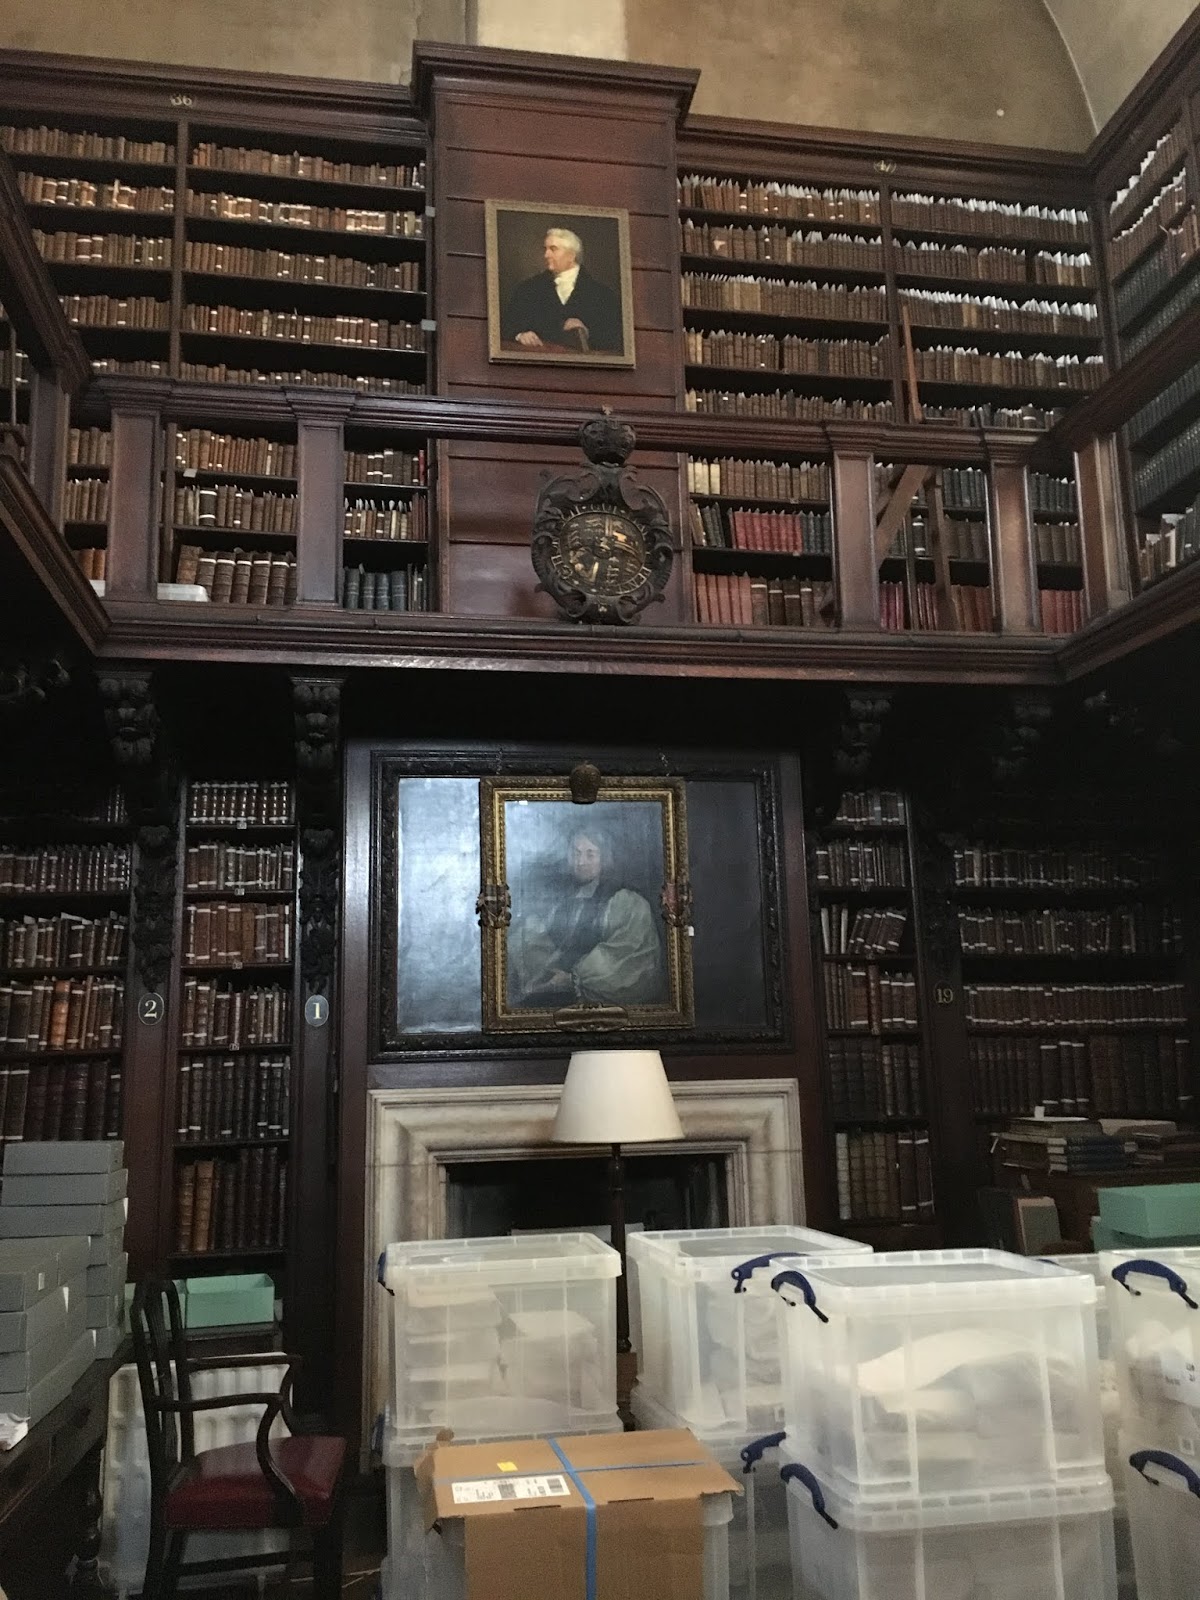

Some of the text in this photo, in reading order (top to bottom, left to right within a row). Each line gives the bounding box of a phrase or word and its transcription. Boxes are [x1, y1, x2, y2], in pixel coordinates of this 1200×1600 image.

[936, 988, 954, 1004] 19
[143, 1000, 157, 1018] 2
[312, 1002, 322, 1020] 1
